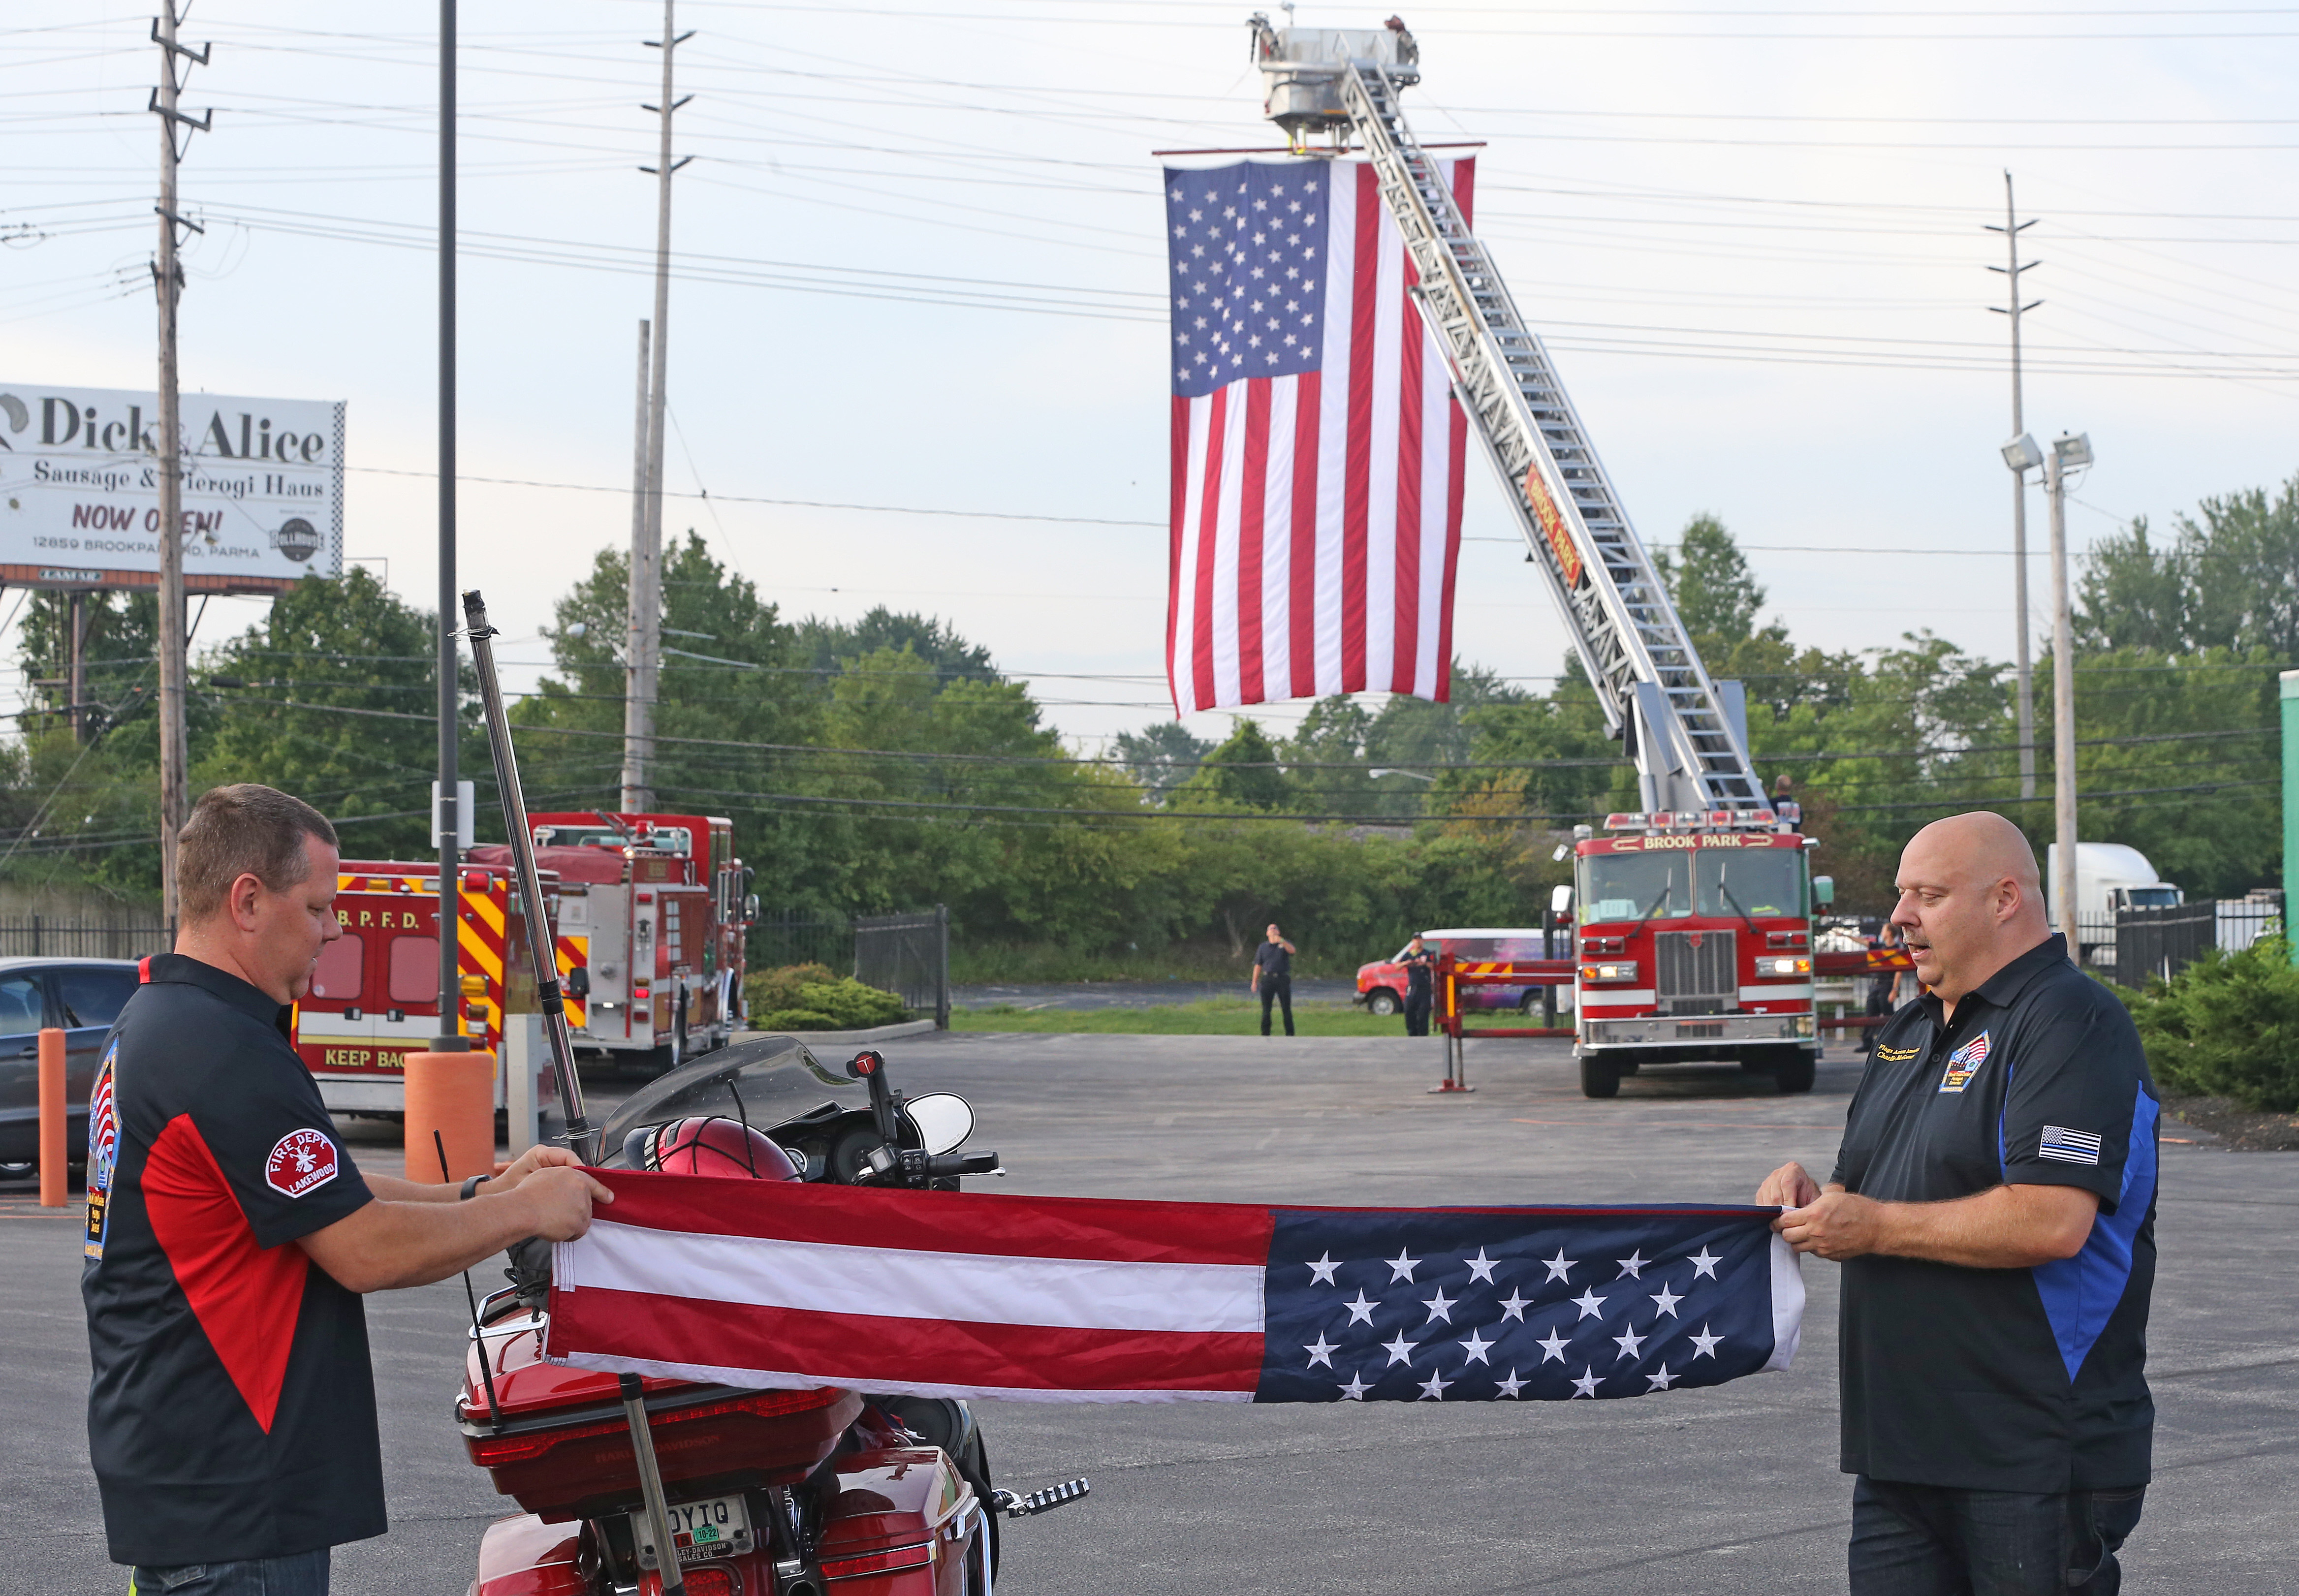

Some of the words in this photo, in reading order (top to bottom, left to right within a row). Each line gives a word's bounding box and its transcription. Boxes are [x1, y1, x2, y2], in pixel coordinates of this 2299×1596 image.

[38, 397, 161, 453] Dick
[198, 410, 324, 463] Alice
[34, 460, 130, 492] Sausage
[140, 468, 156, 488] &
[180, 471, 254, 500] ierogi
[266, 474, 323, 497] Haus
[72, 503, 136, 531] NOW
[145, 509, 223, 534] OEN!
[210, 547, 259, 558] PARMA
[1644, 836, 1696, 850] BROOK
[1701, 834, 1742, 847] PARK
[337, 909, 352, 927] B.
[360, 910, 374, 928] P.
[381, 911, 395, 929] F.
[402, 912, 419, 929] D.
[325, 1049, 371, 1066] KEEP
[377, 1051, 409, 1068] BAC
[1878, 1044, 1894, 1054] Flags
[270, 1140, 295, 1173] FIRE
[295, 1132, 327, 1150] DEPT.
[288, 1163, 335, 1193] LAKEWOOD
[698, 1528, 717, 1538] 10-22
[678, 1552, 701, 1562] SALES
